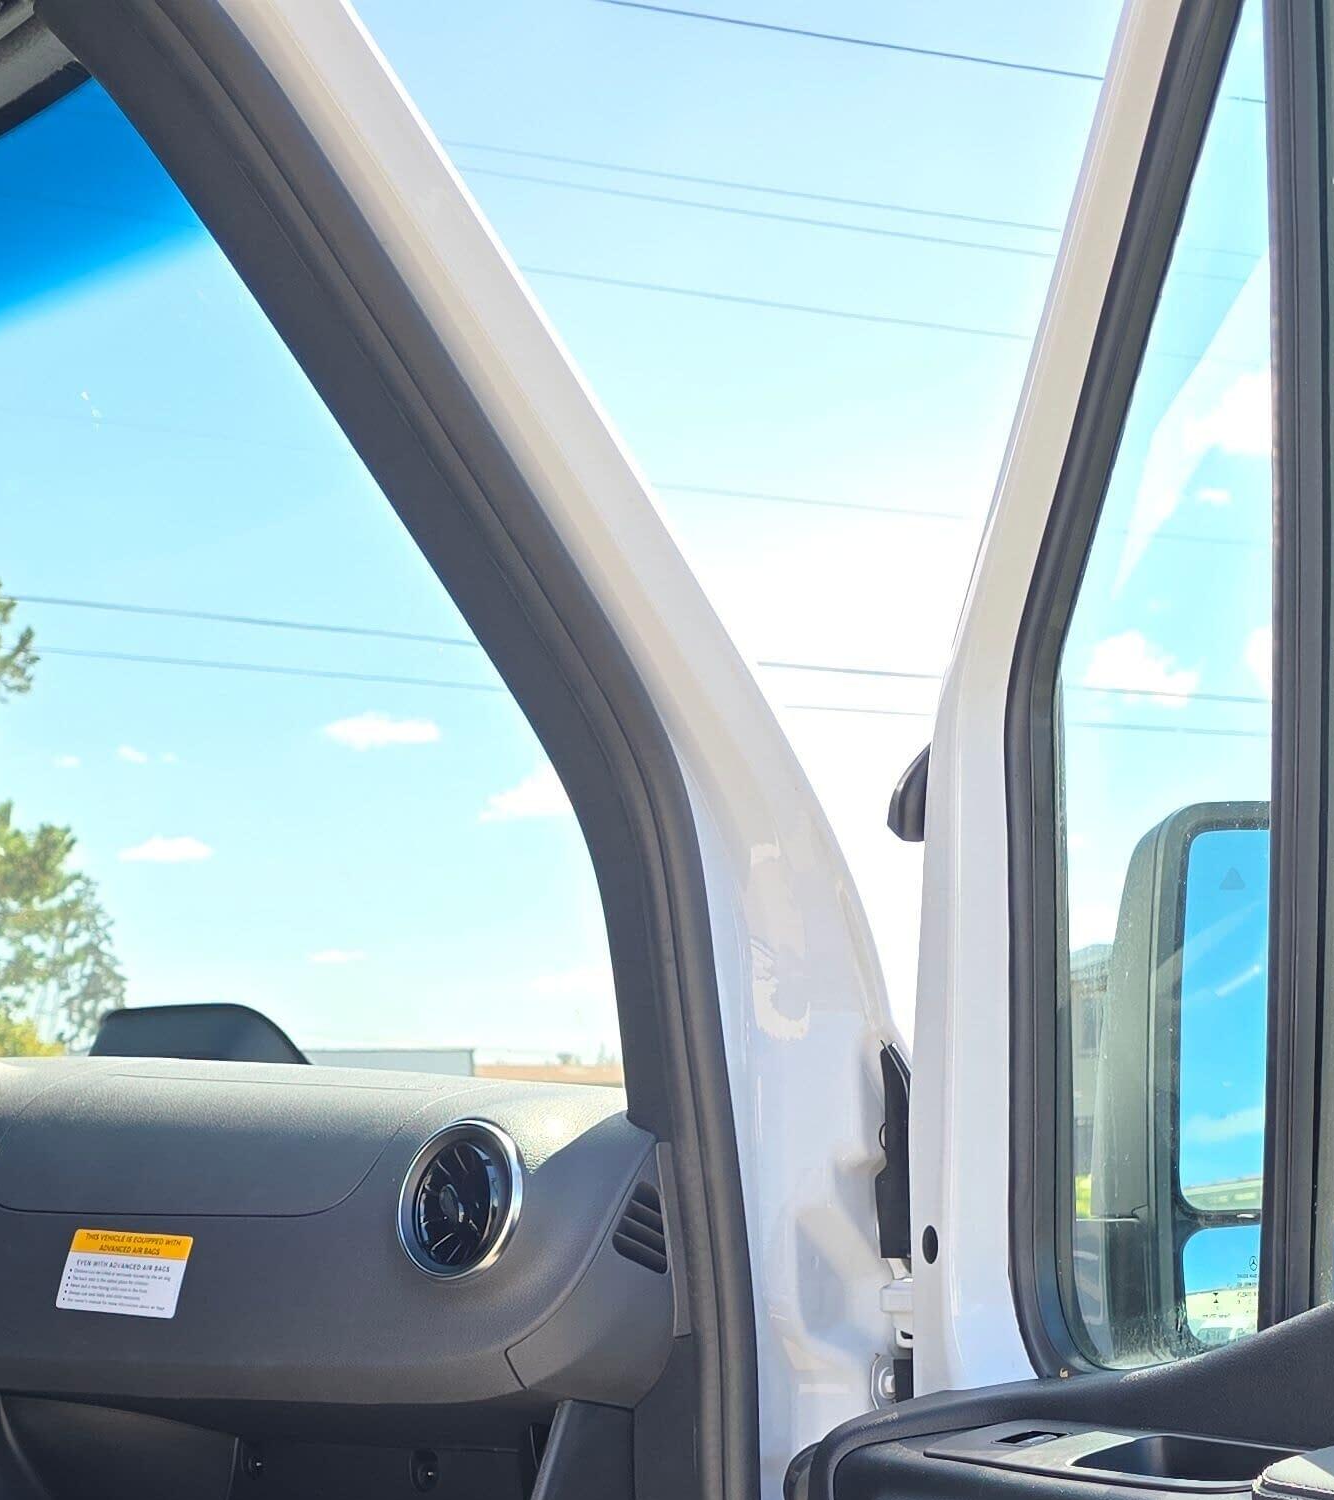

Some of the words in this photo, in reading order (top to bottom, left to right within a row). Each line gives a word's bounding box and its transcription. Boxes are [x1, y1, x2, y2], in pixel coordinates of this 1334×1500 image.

[85, 1232, 99, 1241] THIS
[100, 1233, 126, 1243] VEHICLE
[126, 1235, 133, 1243] IS
[133, 1235, 164, 1246] EQUIPPED
[165, 1238, 182, 1247] WITH
[98, 1244, 132, 1255] ADVANCED
[132, 1246, 144, 1255] AIR
[144, 1247, 161, 1256] BAGS
[76, 1259, 92, 1267] EVEN
[109, 1262, 142, 1271] ADVANCED
[142, 1263, 153, 1271] AIR
[154, 1265, 170, 1273] BAGS
